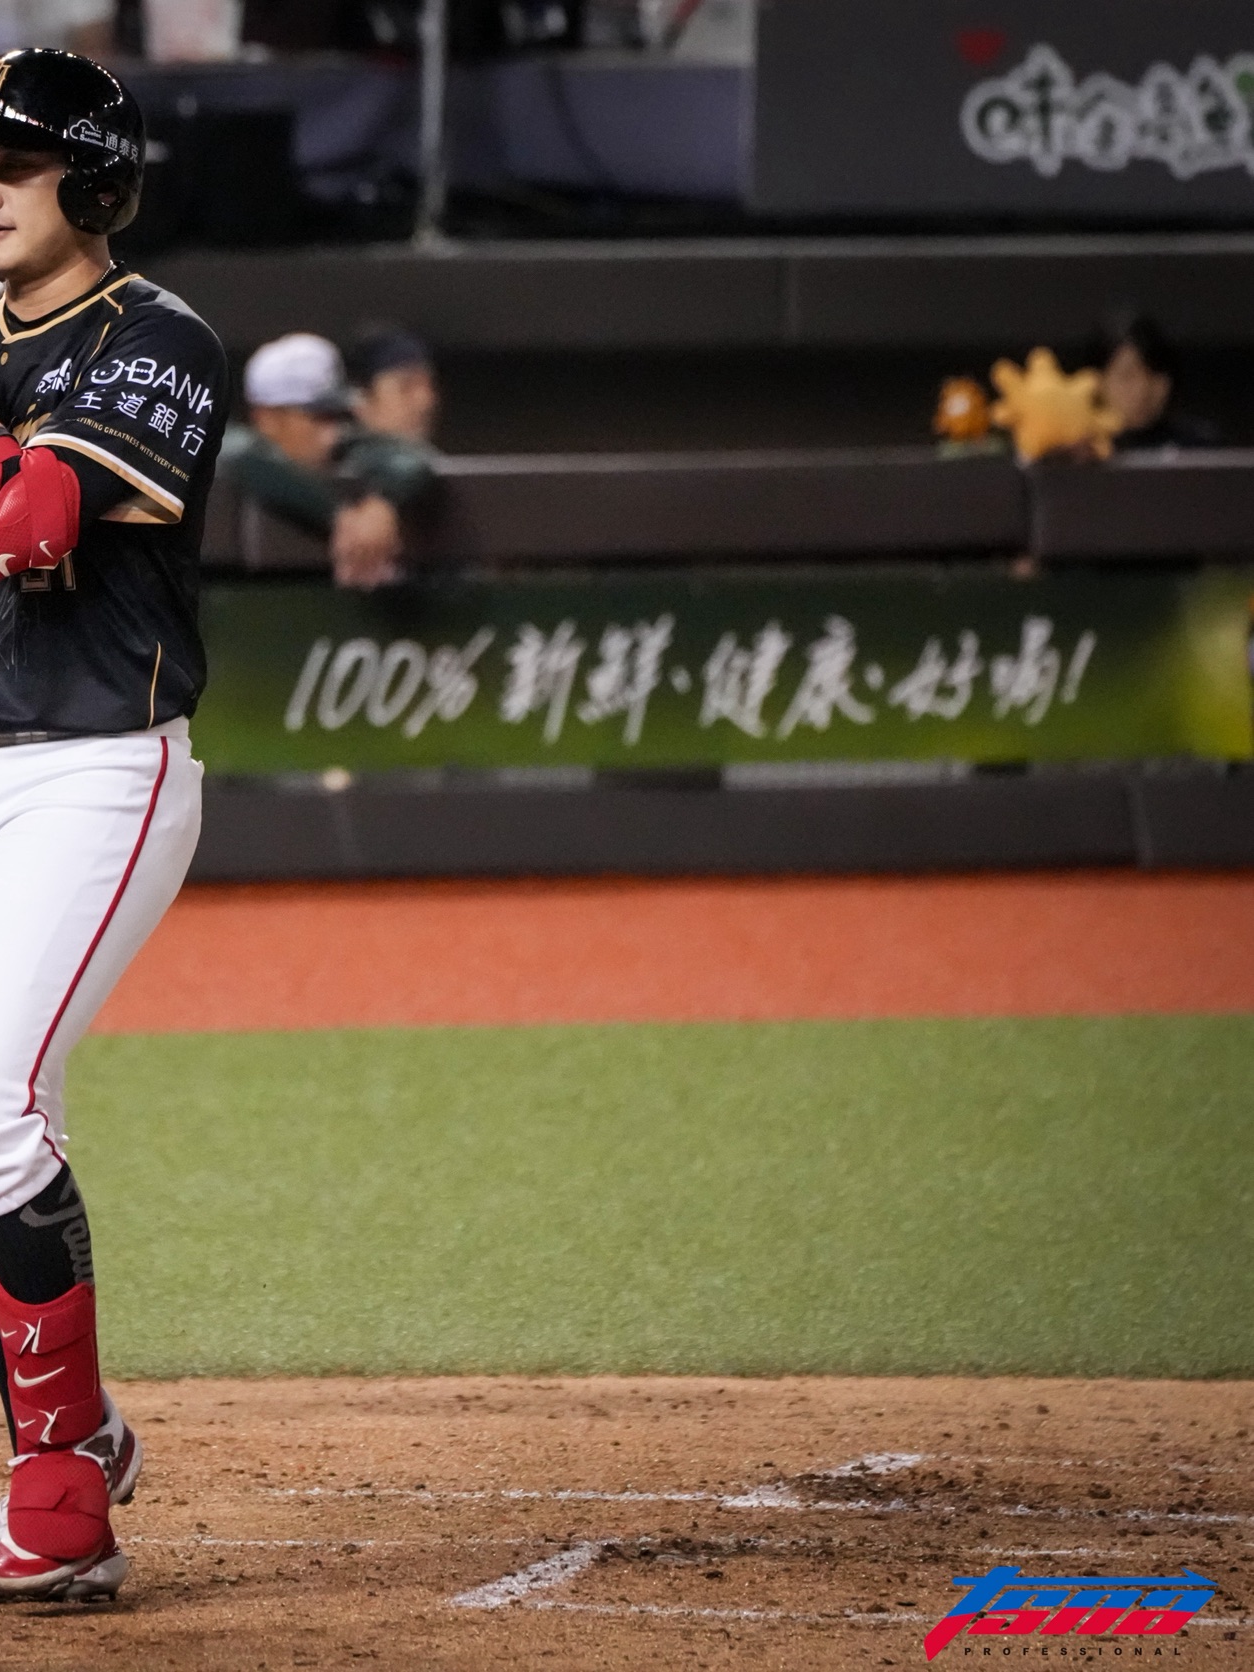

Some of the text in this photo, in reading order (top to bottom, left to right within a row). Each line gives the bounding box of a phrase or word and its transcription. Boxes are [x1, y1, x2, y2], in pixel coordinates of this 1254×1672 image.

[74, 389, 207, 456] 王道銀行
[104, 427, 139, 448] GREATNESS
[139, 444, 154, 457] WITH
[154, 455, 171, 470] EVERY
[171, 465, 190, 482] SWING
